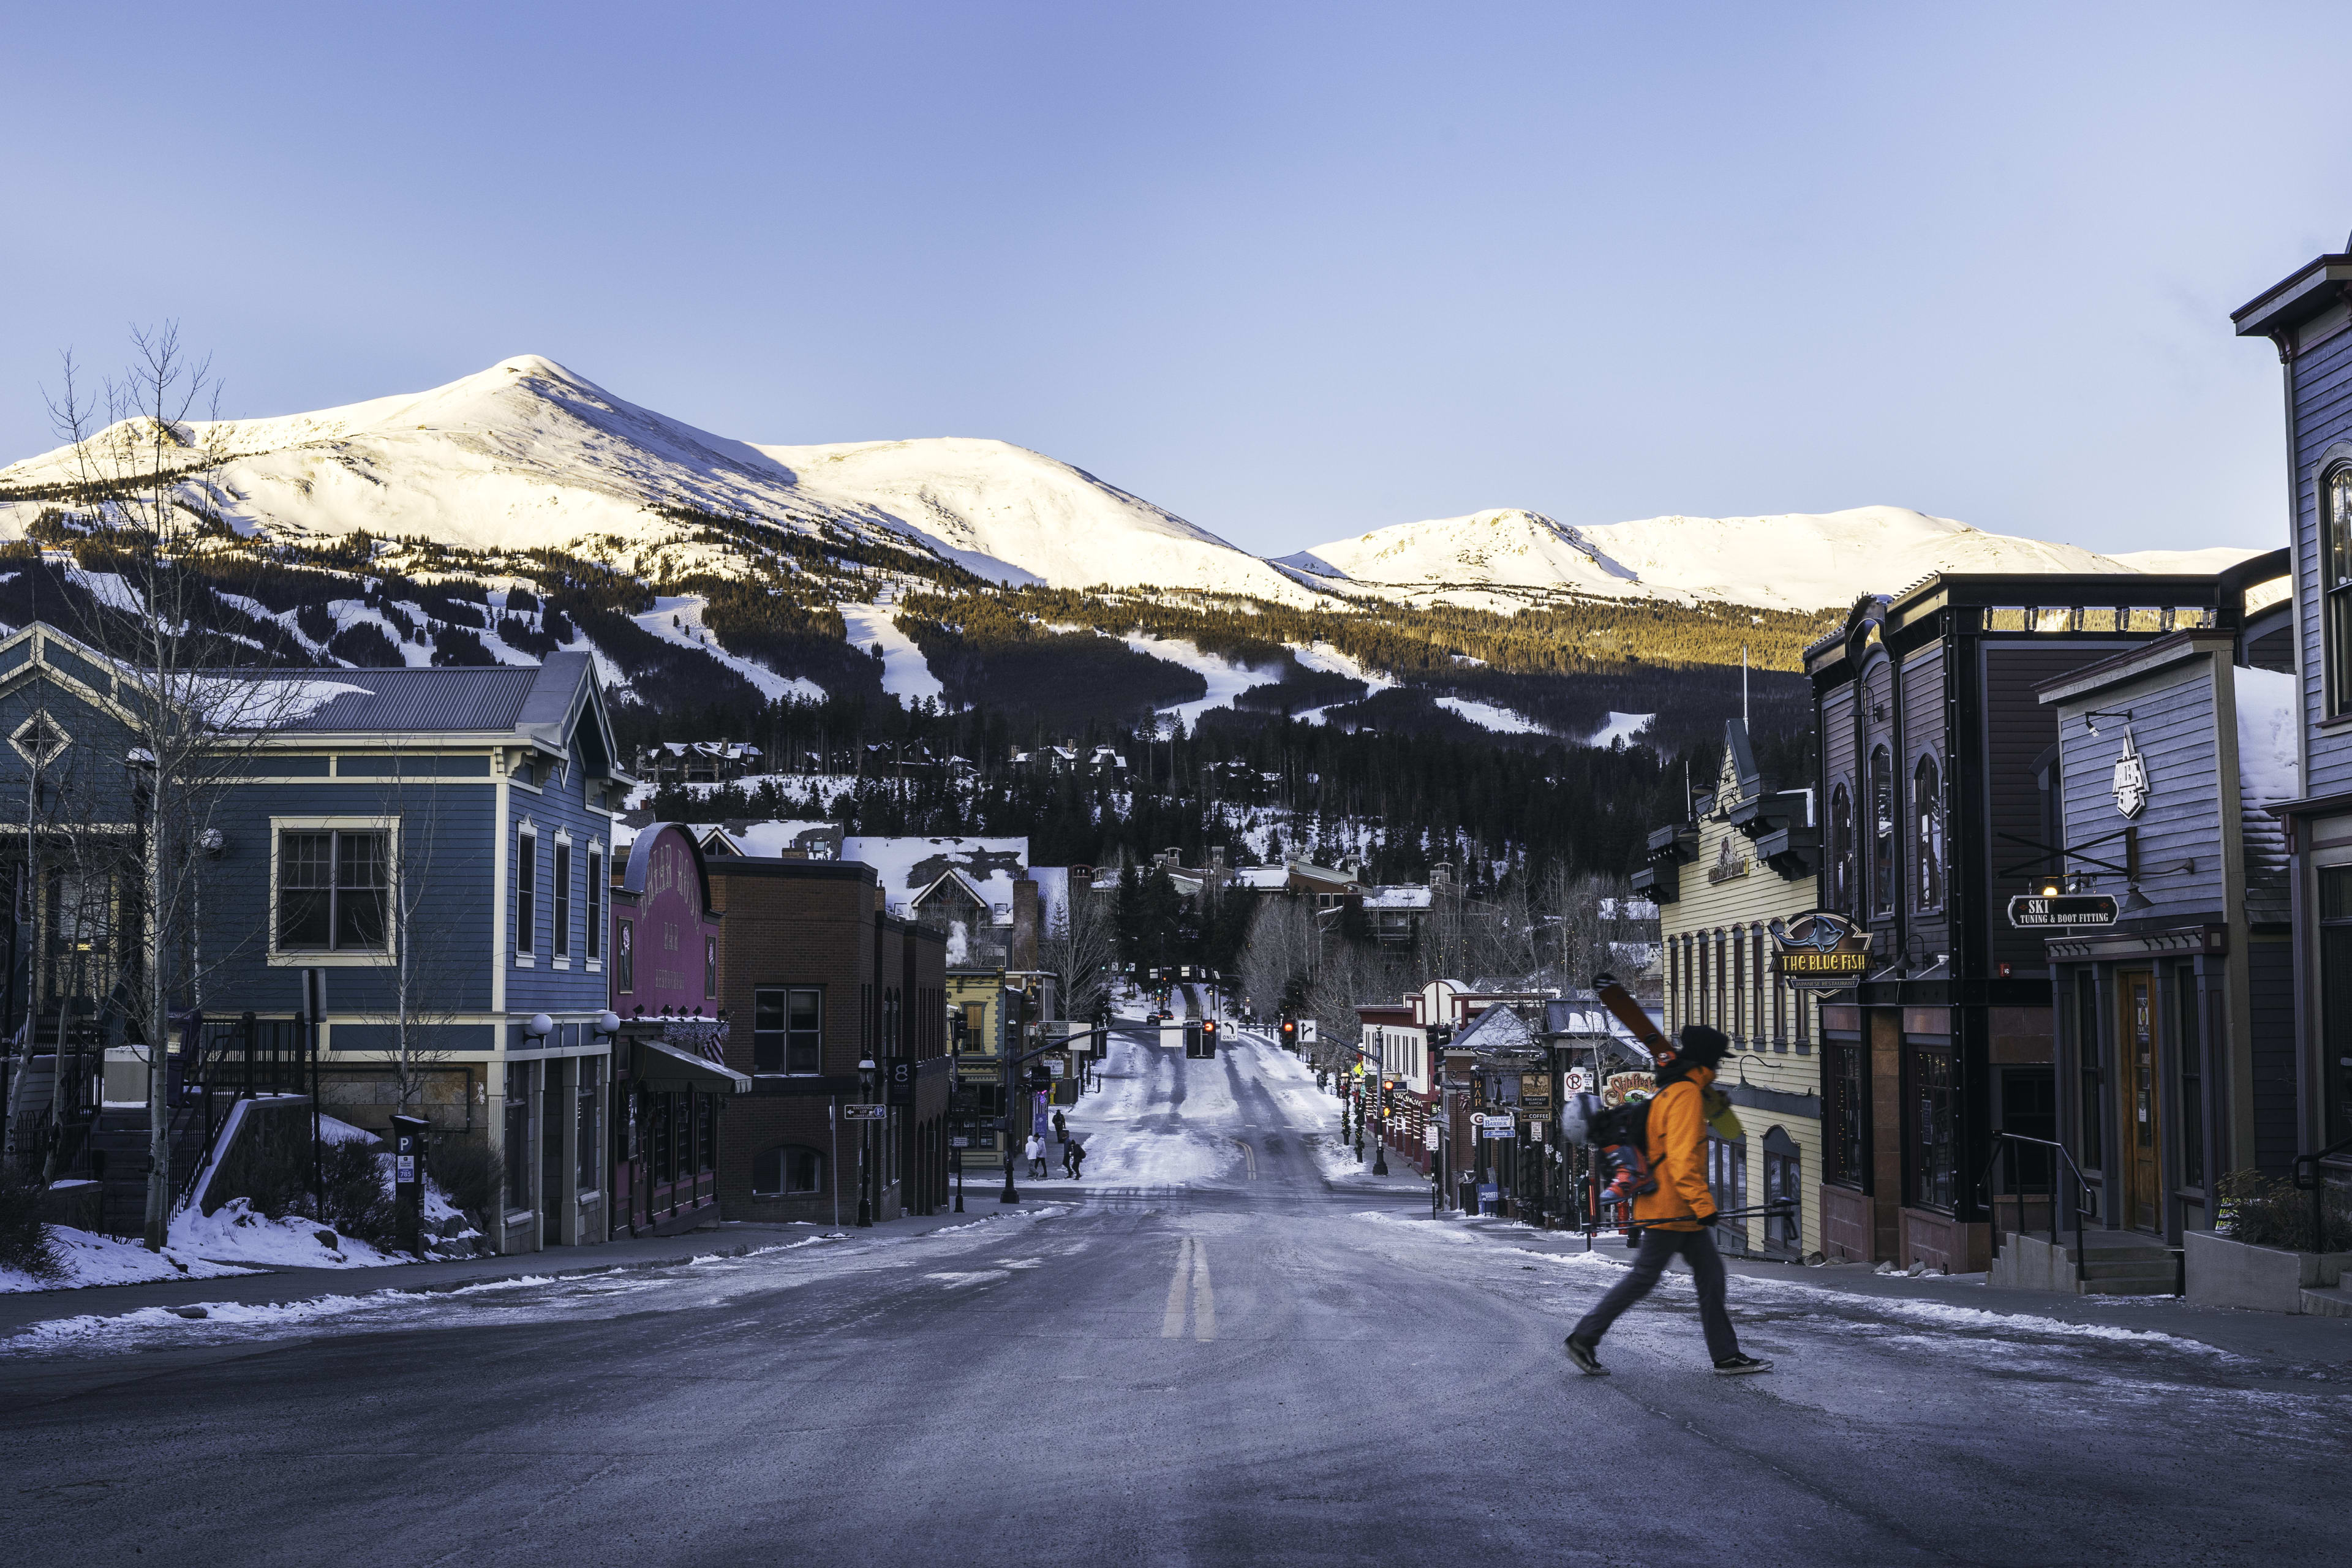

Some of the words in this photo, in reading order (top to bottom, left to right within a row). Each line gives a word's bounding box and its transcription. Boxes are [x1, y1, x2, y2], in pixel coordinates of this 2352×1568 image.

[640, 844, 673, 925] BRIAR
[677, 849, 701, 936] ROSE
[2019, 914, 2048, 924] TUNING
[2050, 914, 2056, 924] &
[2057, 913, 2078, 923] BOOT
[2079, 912, 2109, 922] FITTING
[2028, 899, 2049, 914] SKI
[664, 922, 679, 951] BAR
[655, 969, 685, 990] RESTAURANT
[1474, 1079, 1483, 1107] BAR
